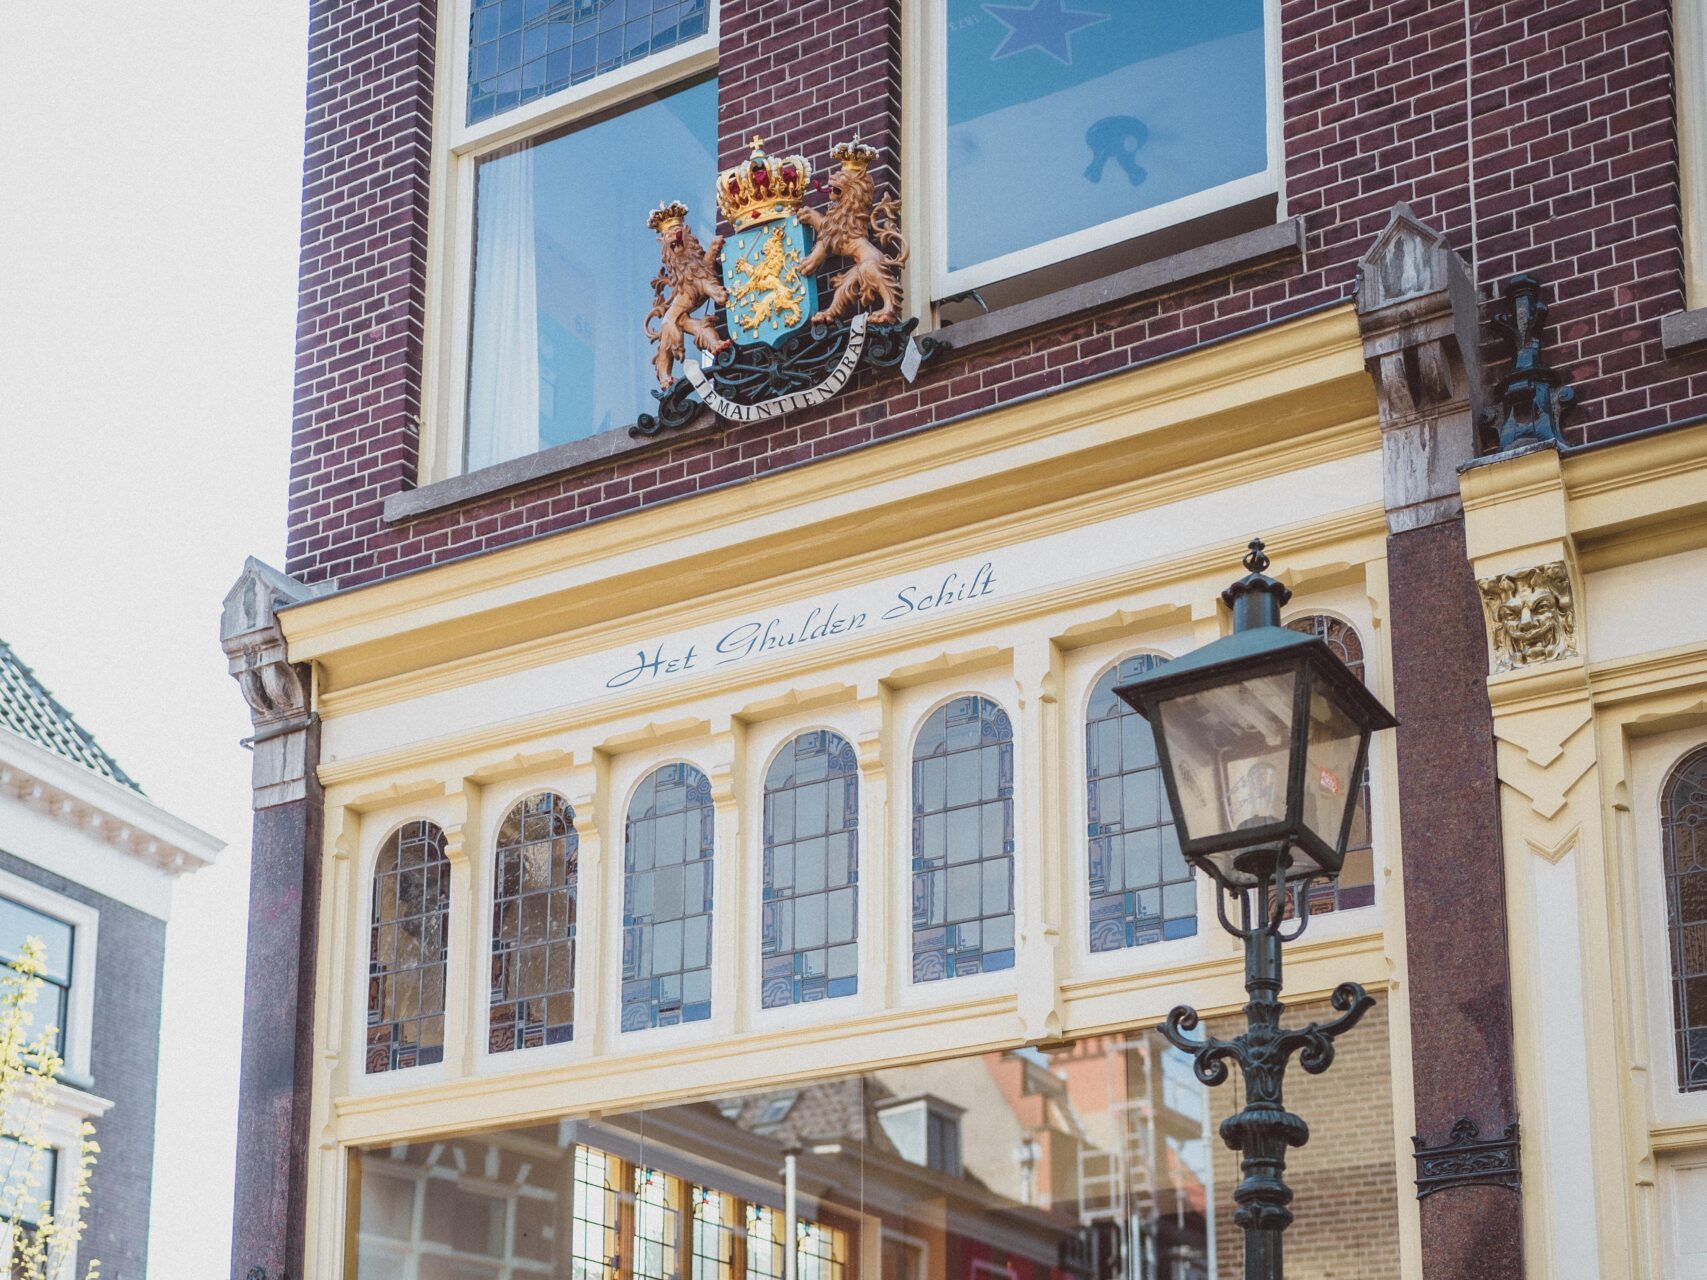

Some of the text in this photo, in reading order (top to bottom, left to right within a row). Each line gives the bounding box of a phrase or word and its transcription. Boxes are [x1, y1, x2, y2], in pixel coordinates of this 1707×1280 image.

[606, 561, 998, 689] Het Ghulden Schilt
